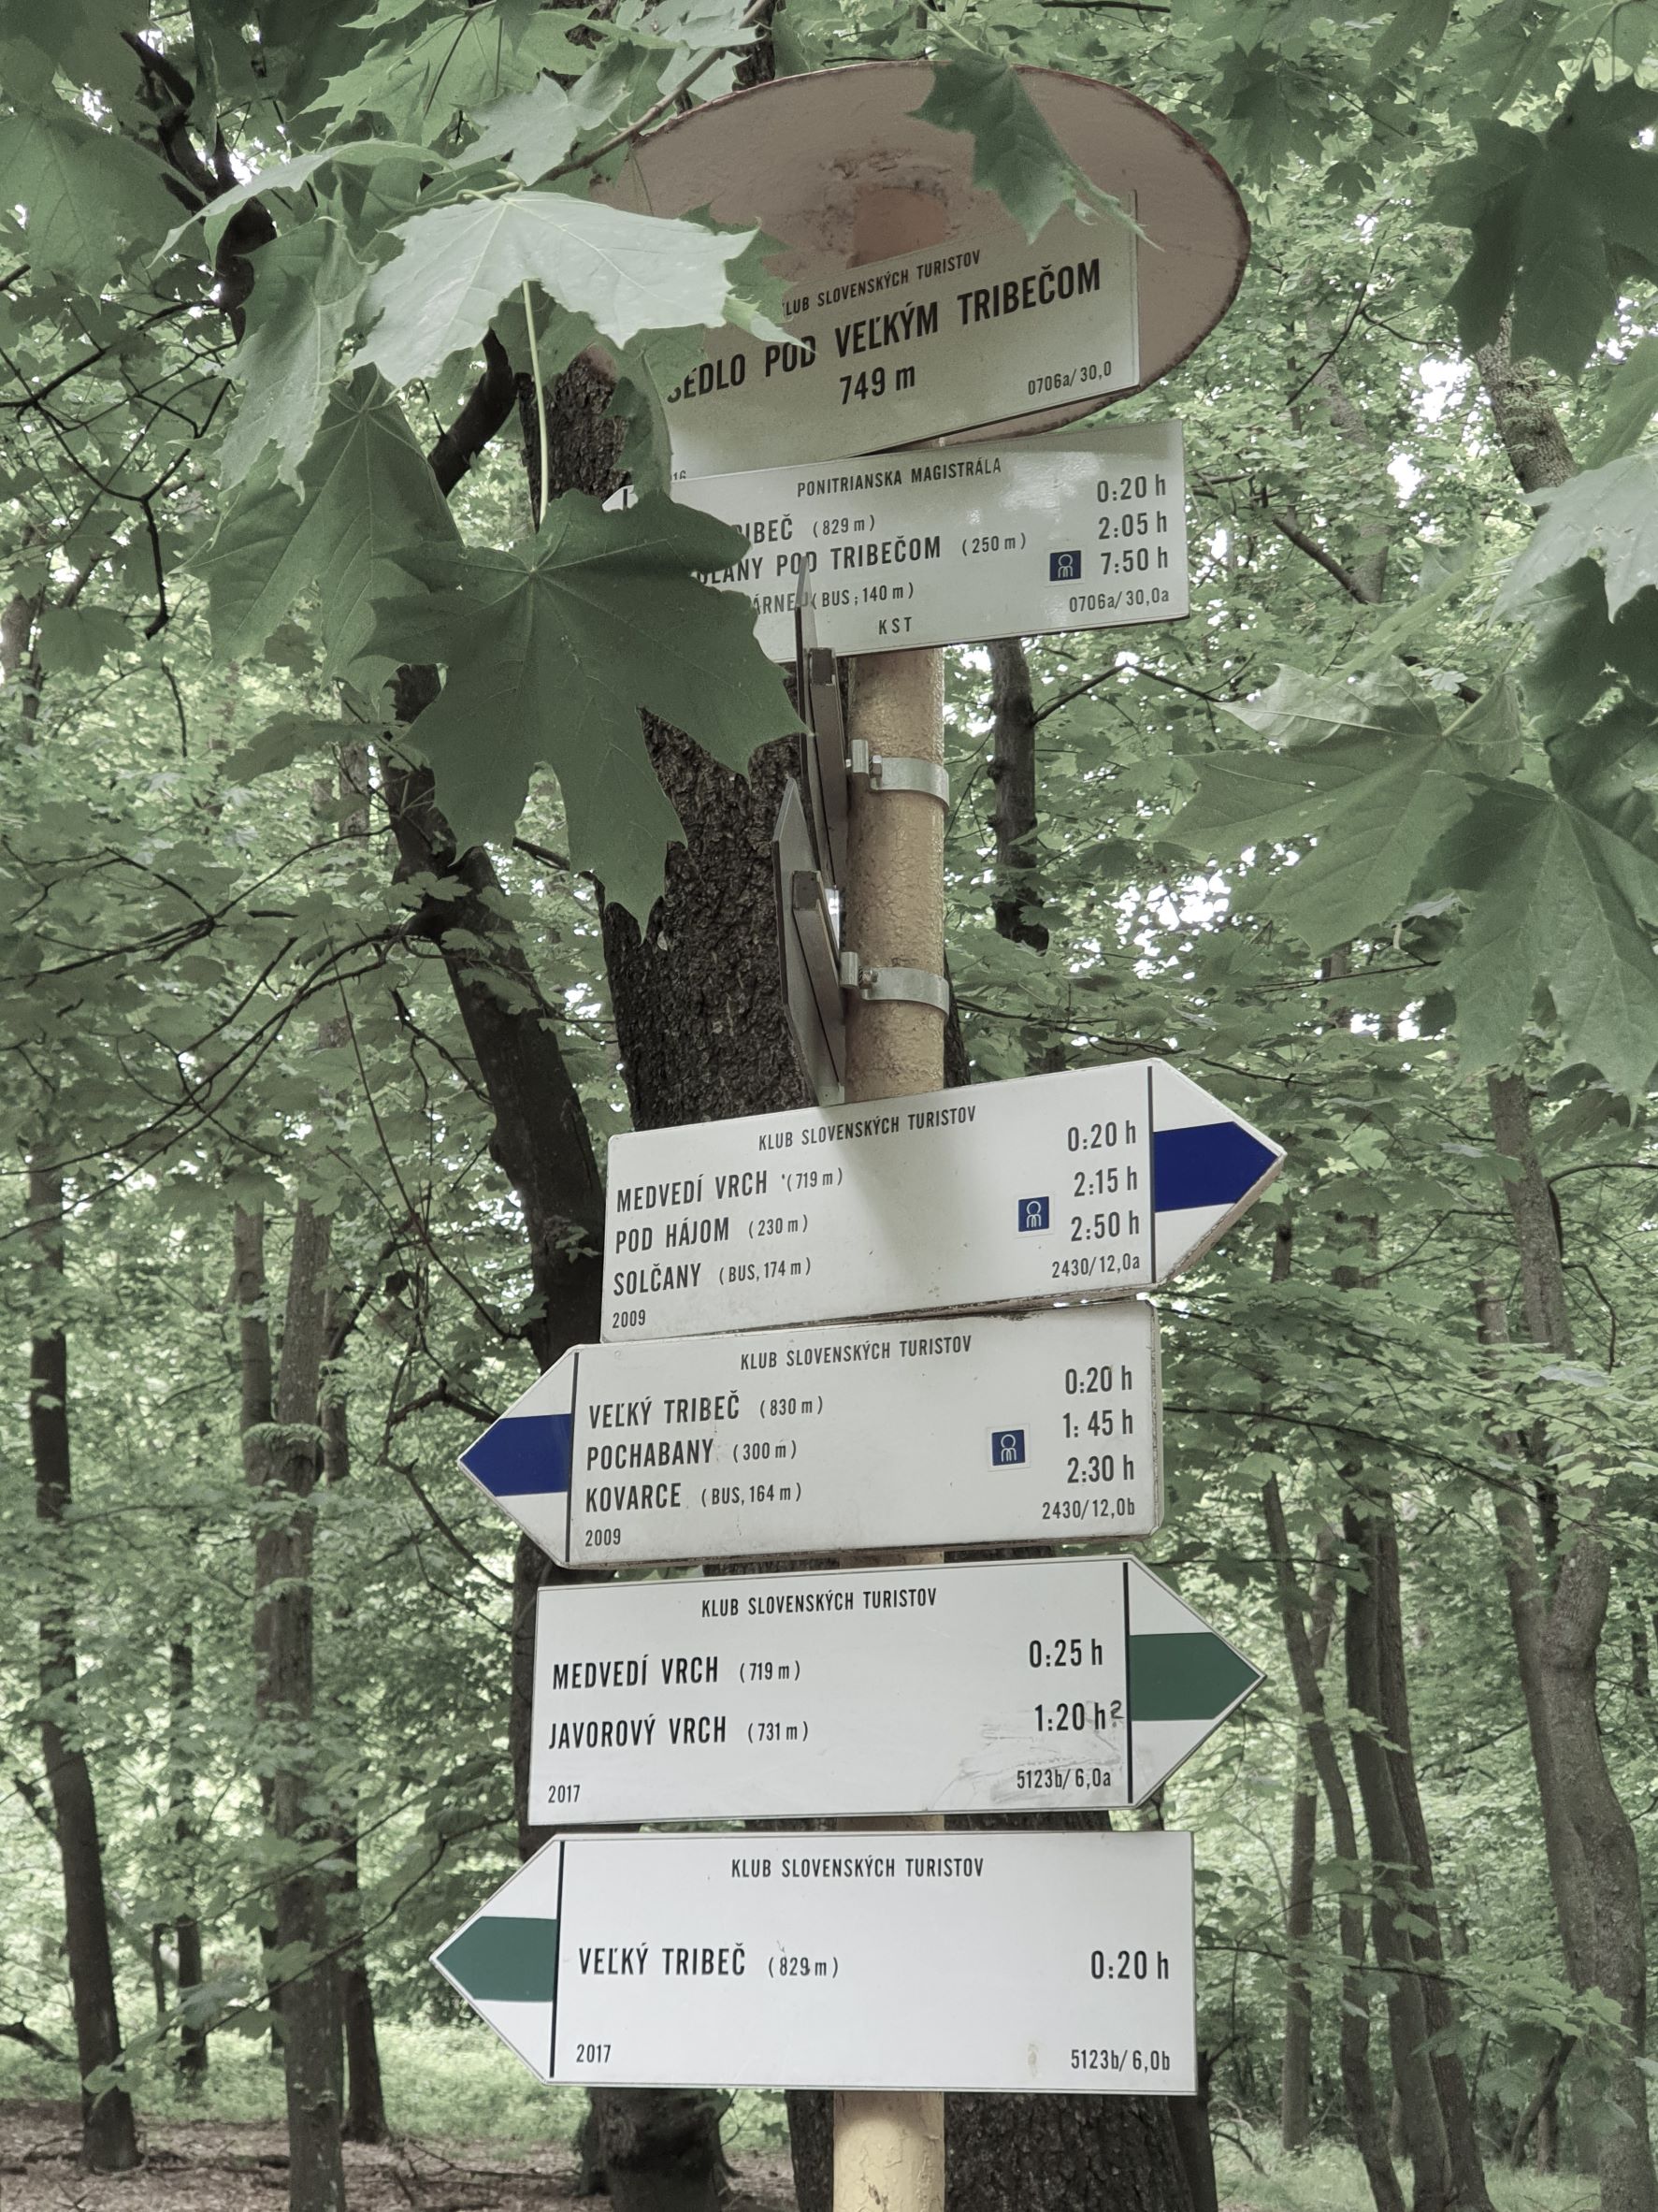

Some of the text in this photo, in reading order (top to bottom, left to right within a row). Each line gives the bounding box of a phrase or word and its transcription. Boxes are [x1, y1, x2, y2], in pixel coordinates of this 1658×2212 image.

[782, 249, 981, 318] LUB SLOVENSKÝCH TURISTOV
[765, 335, 817, 378] POD
[835, 300, 939, 359] VEĽKÝM
[957, 257, 1102, 326] TRIBEČOM
[839, 366, 916, 405] 749 m
[797, 457, 1002, 498] PONITRIANSKA MAGISTRÁLA
[1097, 475, 1147, 503] 0:20
[1155, 473, 1166, 497] h
[776, 550, 817, 577] POD
[829, 535, 941, 571] TRIBEČOM
[1098, 512, 1148, 541] 2:05
[1156, 510, 1167, 533] h
[1100, 547, 1149, 575] 7:50
[1157, 545, 1168, 569] h
[758, 1105, 977, 1151] KLUB SLOVENSKÝCH TURISTOV
[615, 1172, 705, 1214] MEDVEDÍ
[714, 1170, 767, 1200] VRCH
[1067, 1121, 1117, 1152] 0:20
[1125, 1120, 1136, 1145] h
[615, 1226, 653, 1254] POD
[664, 1215, 731, 1250] HÁJOM
[1074, 1167, 1118, 1197] 2:15
[1127, 1165, 1138, 1191] h
[612, 1260, 703, 1298] SOLČANY
[1071, 1211, 1120, 1242] 2:50
[1129, 1209, 1140, 1236] h
[612, 1308, 646, 1329] 2009
[741, 1334, 973, 1370] KLUB SLOVENSKÝCH TURISTOV
[588, 1395, 654, 1430] VEĽKÝ
[663, 1389, 742, 1425] TRIBEČ
[1065, 1366, 1113, 1395] 0:20
[1121, 1365, 1132, 1391] h
[585, 1437, 715, 1472] POCHABANY
[1121, 1408, 1133, 1435] h
[584, 1481, 684, 1514] KOVARCE
[1067, 1454, 1115, 1483] 2:30
[1122, 1453, 1134, 1481] h
[584, 1527, 621, 1547] 2009
[701, 1586, 938, 1618] KLUB SLOVENSKÝCH TURISTOV
[552, 1654, 650, 1691] MEDVEDÍ
[661, 1655, 718, 1684] VRCH
[1029, 1639, 1082, 1669] 0:25
[1090, 1638, 1103, 1666] h
[548, 1713, 656, 1750] JAVOROVÝ
[669, 1715, 726, 1744] VRCH
[1032, 1700, 1087, 1733] 1:20
[1093, 1701, 1107, 1731] h
[548, 1784, 581, 1803] 2017
[731, 1854, 984, 1879] KLUB SLOVENSKÝCH TURISTOV
[577, 1942, 649, 1976] VEĽKÝ
[660, 1942, 746, 1977] TRIBEČ
[1090, 1950, 1147, 1980] 0:20
[1157, 1950, 1169, 1980] h
[576, 2044, 612, 2063] 2017
